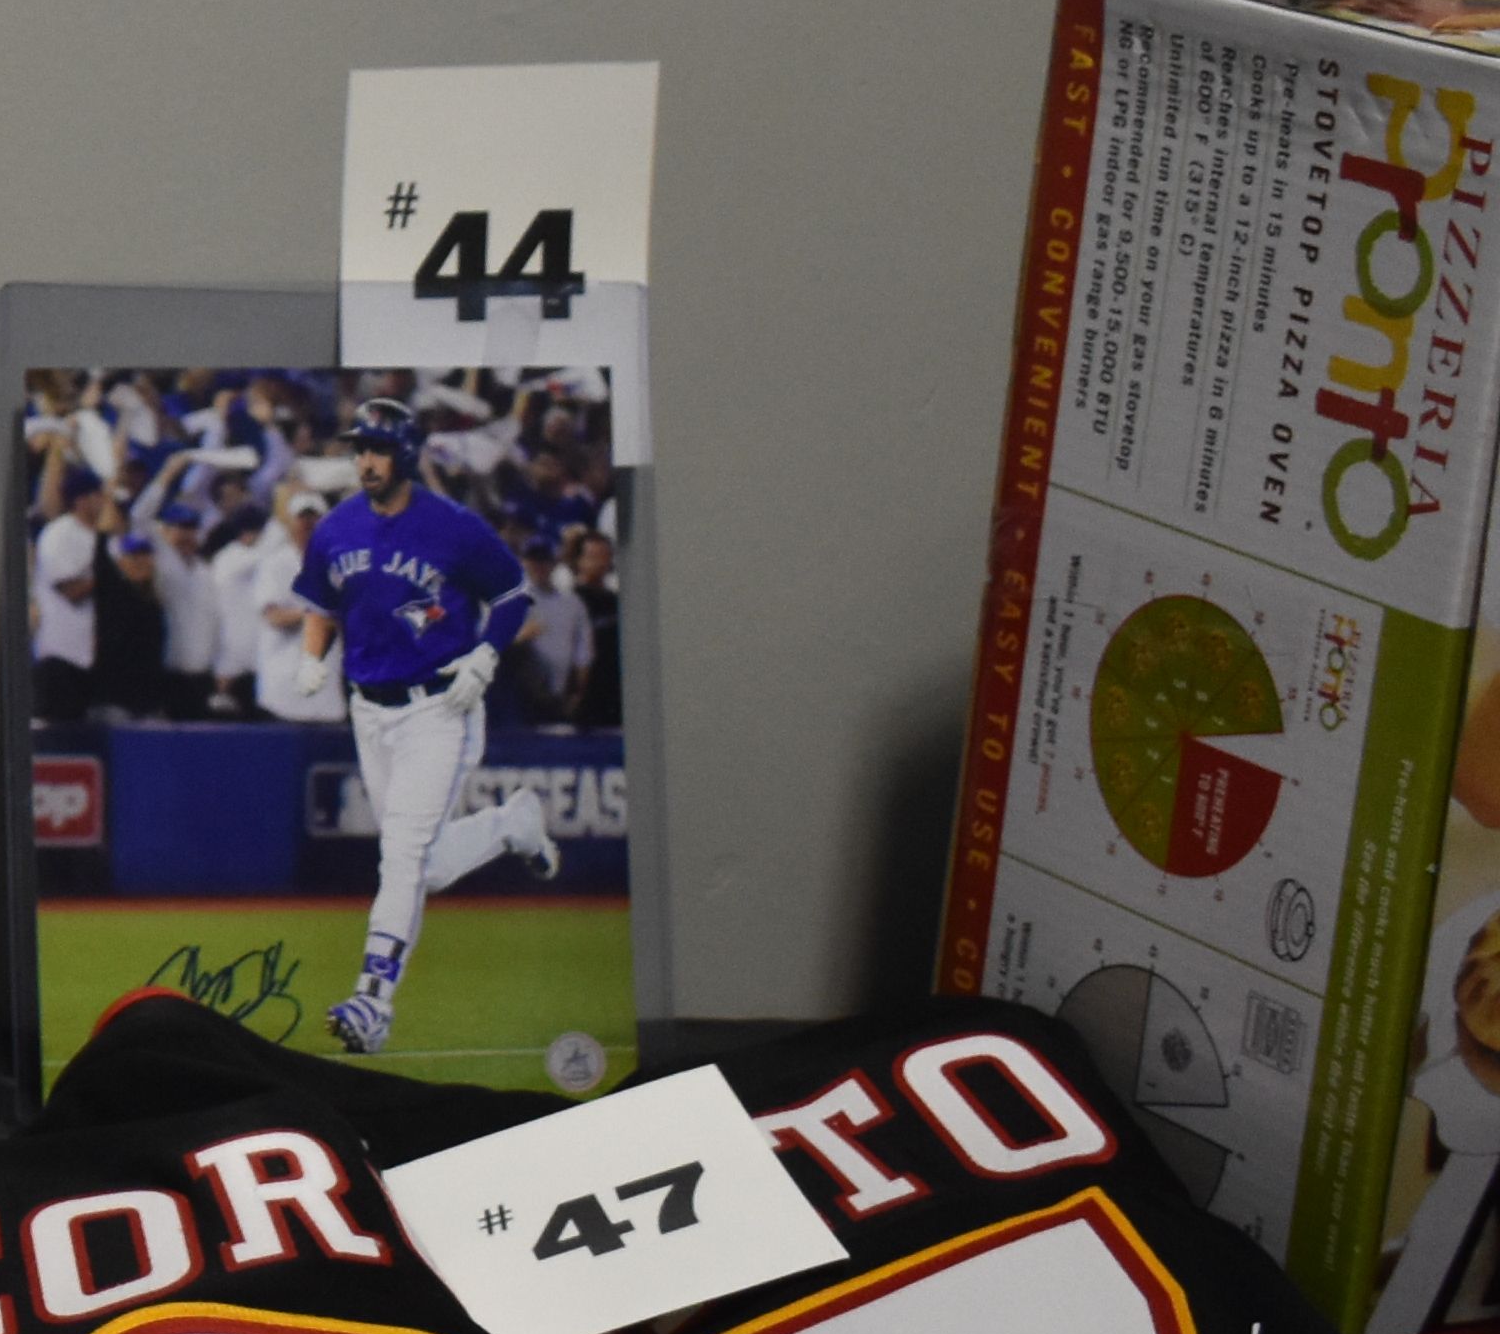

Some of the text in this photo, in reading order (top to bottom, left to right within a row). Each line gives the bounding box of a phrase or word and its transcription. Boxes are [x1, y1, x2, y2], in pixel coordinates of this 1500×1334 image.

[1063, 24, 1096, 137] FAST
[1121, 24, 1158, 184] Recommended
[1198, 40, 1216, 63] of
[384, 180, 585, 323] #44
[1075, 19, 1135, 411] NG or LPG indoor gas range burners
[1114, 32, 1188, 472] Unlimited run time on your gas stovetop
[1121, 191, 1137, 221] for
[1180, 45, 1239, 387] Reaches internal temperatures
[1194, 54, 1269, 515] Cooks up to a 12-inch pizza in 6 minutes
[1252, 63, 1301, 334] Pre-heats in 15 minutes
[1260, 58, 1340, 525] STOVETOP PIZZA OVEN
[1315, 72, 1475, 561] pronto
[1407, 135, 1494, 517] PIZZERIA
[1015, 208, 1074, 499] CONVENIENT
[1092, 391, 1111, 435] BTU
[967, 570, 1028, 870] EASY TO USE
[478, 1161, 704, 1261] #47
